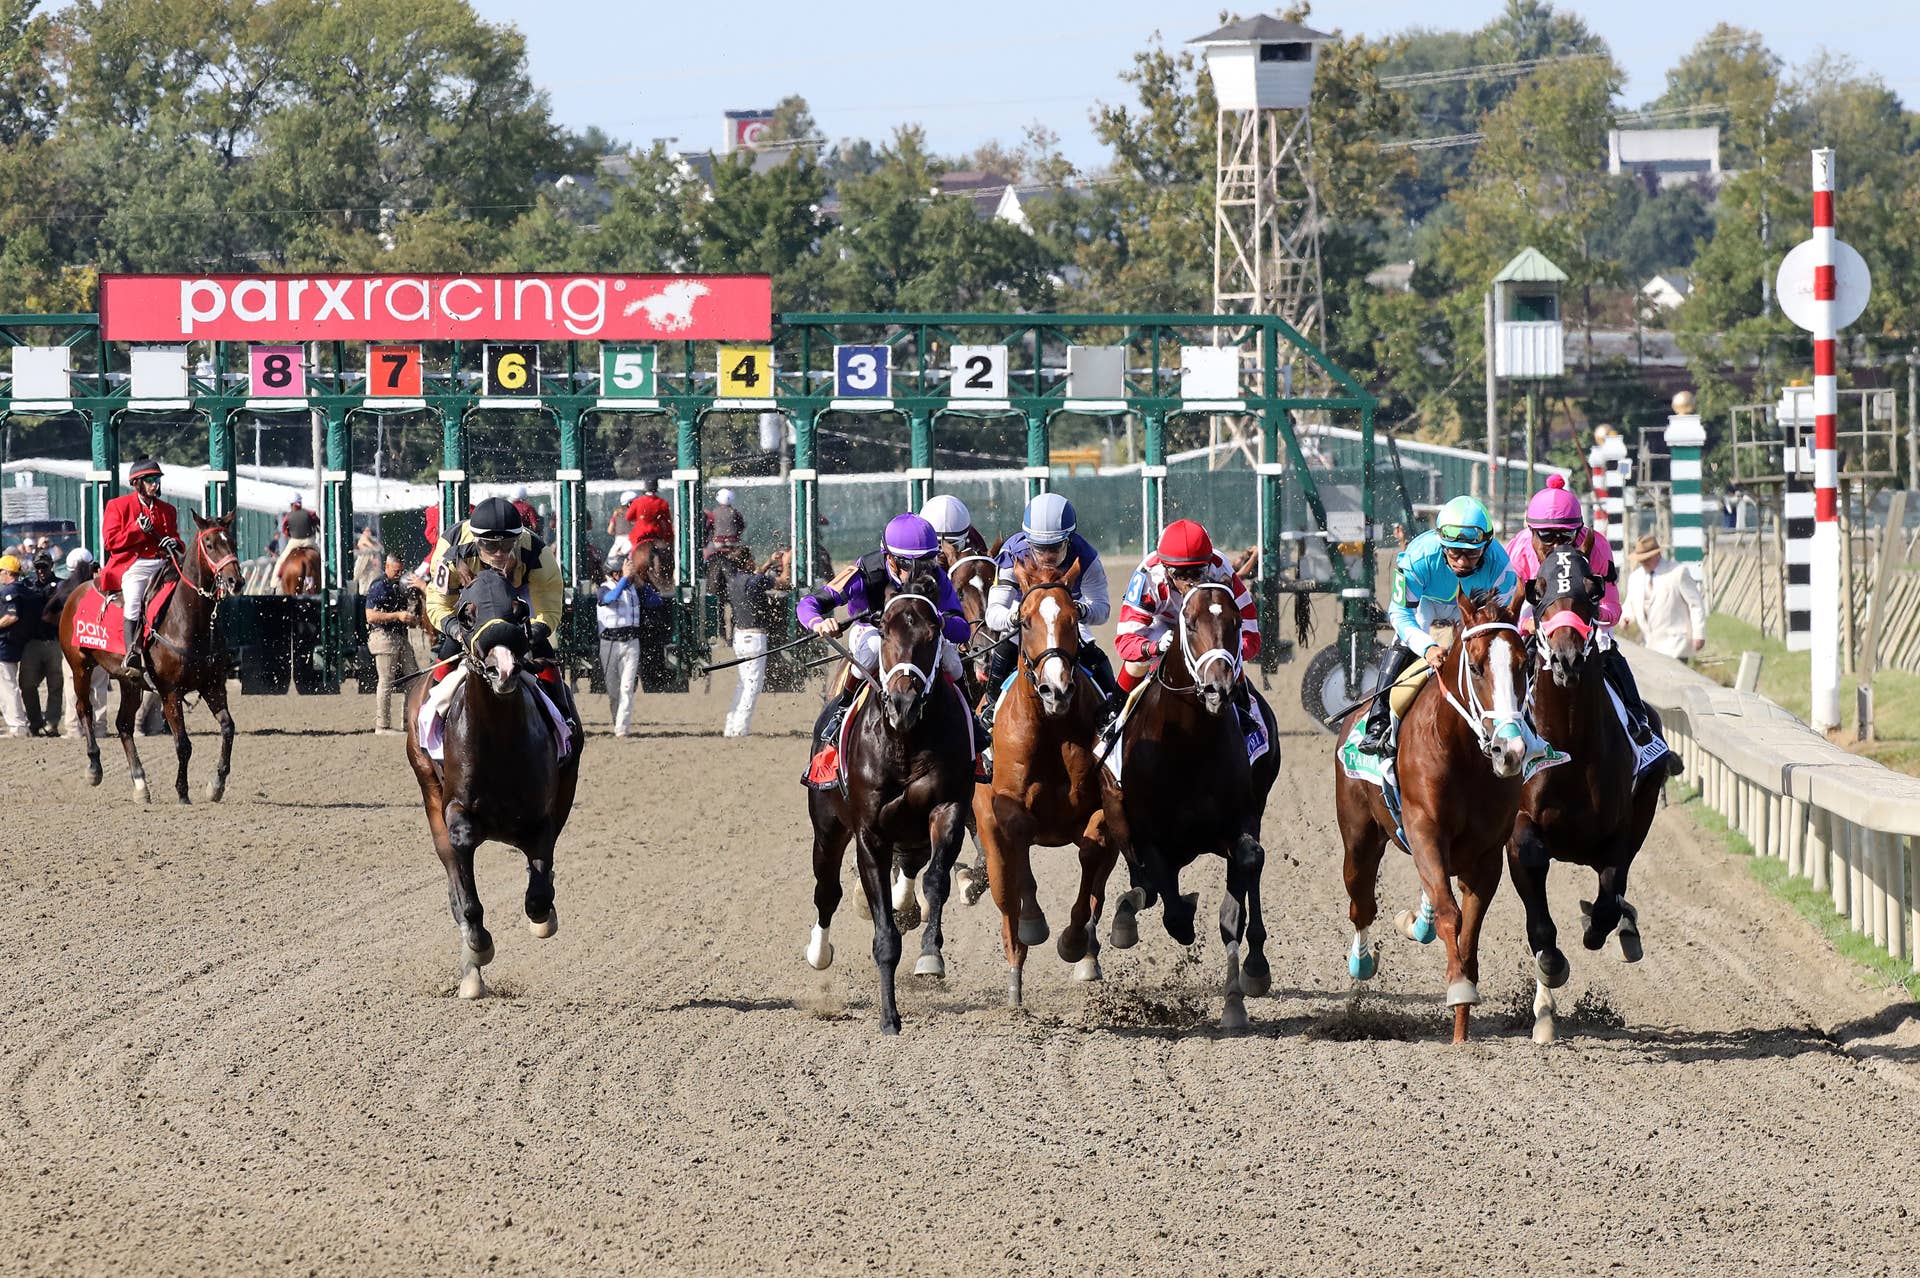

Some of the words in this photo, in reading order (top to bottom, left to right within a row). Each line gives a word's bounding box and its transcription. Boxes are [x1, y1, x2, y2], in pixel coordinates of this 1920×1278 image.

[262, 354, 292, 388] 8
[381, 354, 408, 388] 7
[497, 352, 528, 389] 6
[612, 353, 644, 389] 5
[730, 355, 760, 388] 4
[846, 354, 878, 390] 3
[964, 355, 993, 389] 2
[436, 564, 447, 588] 8
[832, 568, 855, 586] 7
[1128, 573, 1143, 603] 3
[1393, 572, 1405, 604] 5
[76, 620, 110, 640] parx
[80, 635, 107, 649] racing
